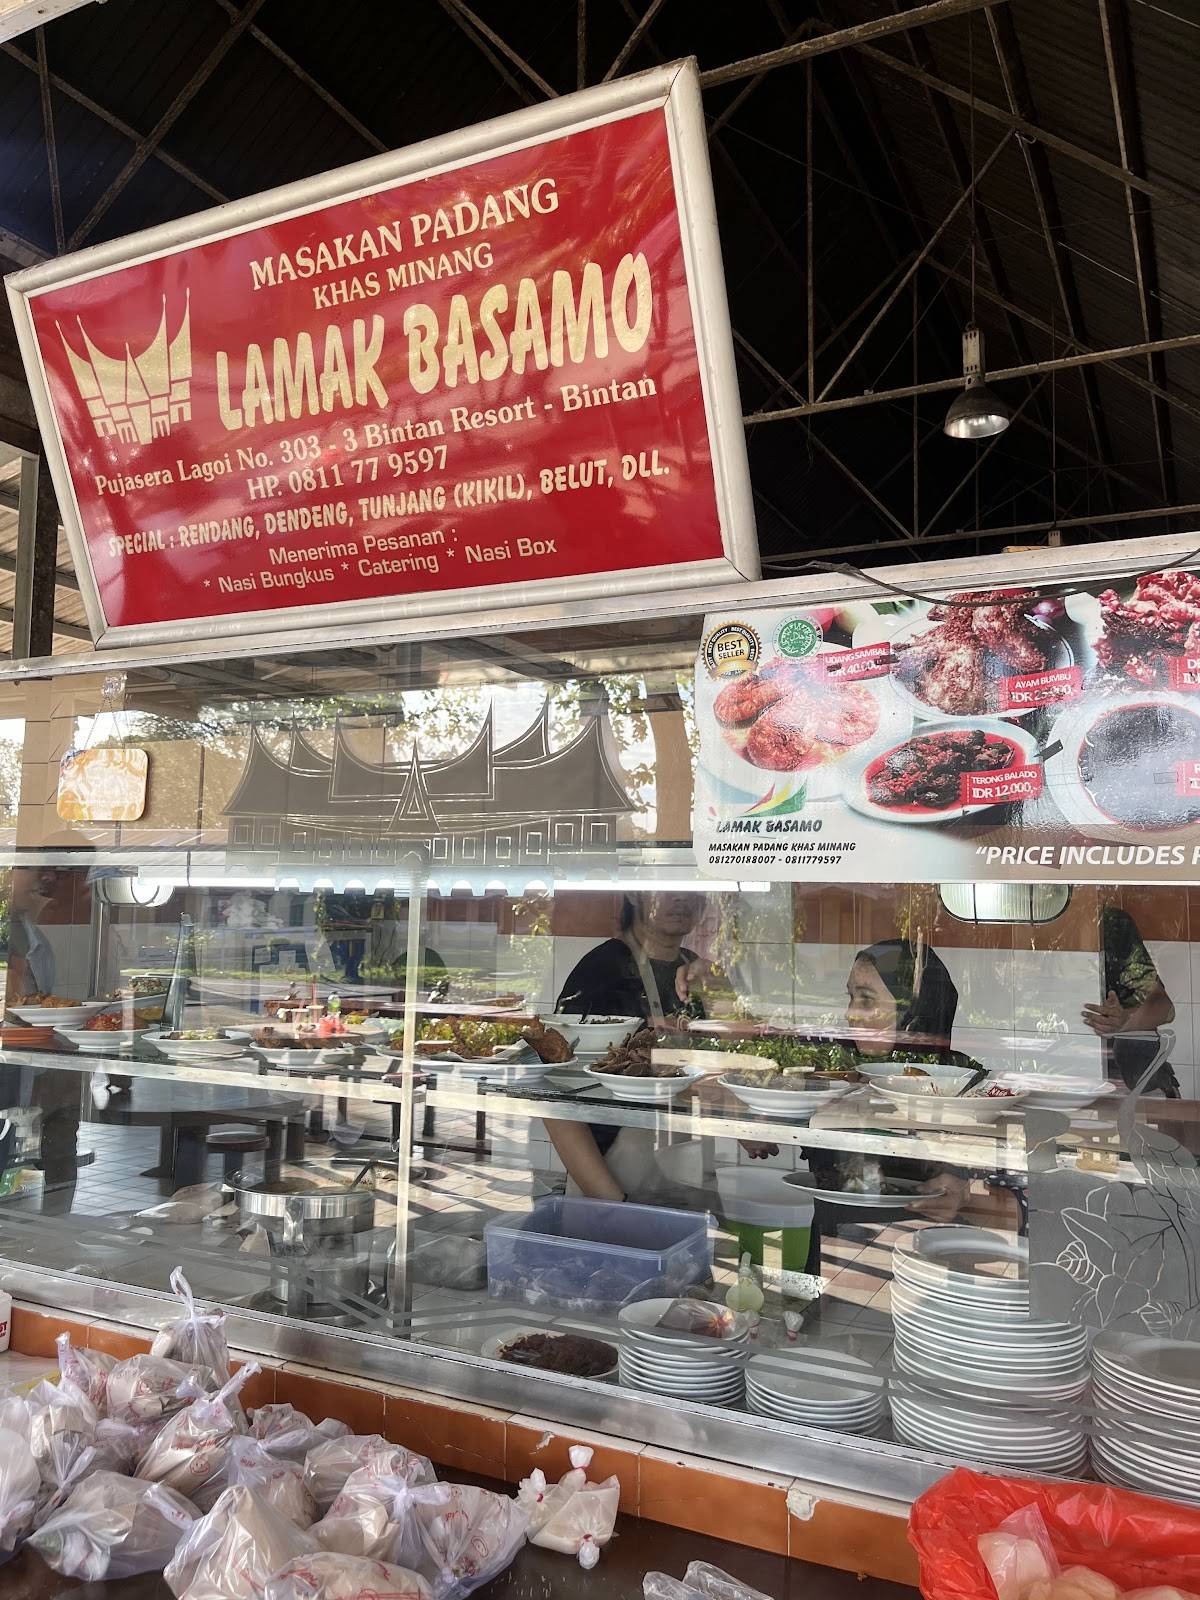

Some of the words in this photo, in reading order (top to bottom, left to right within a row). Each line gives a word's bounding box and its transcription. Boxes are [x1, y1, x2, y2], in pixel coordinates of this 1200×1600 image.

[250, 221, 402, 290] MASAKAN
[411, 178, 559, 247] PADANG
[313, 272, 381, 309] KHAS
[386, 243, 494, 291] MINANG
[216, 314, 389, 430] LAMAK
[403, 252, 653, 394] BASAMO
[95, 469, 174, 497] Pujasera
[177, 453, 232, 483] Lagoi
[236, 448, 273, 471] No.
[279, 435, 322, 464] 303
[344, 428, 358, 452] 3
[364, 416, 445, 449] Bintan
[450, 396, 537, 433] Resort
[560, 377, 657, 412] Bintan
[248, 475, 282, 500] HP.
[288, 465, 344, 494] 0811
[351, 457, 378, 484] 77
[388, 445, 448, 477] 9597
[108, 530, 166, 557] SPECIAL
[178, 516, 260, 548] RENDANG,
[264, 502, 354, 535] DENDENG,
[358, 486, 446, 521] TUNJANG
[453, 473, 533, 509] (KIKIL),
[539, 459, 614, 494] BELUT,
[621, 449, 670, 481] DLL.
[268, 541, 358, 565] Menerima
[363, 530, 445, 554] Pesanan
[218, 573, 256, 593] Nasi
[262, 566, 334, 589] Bungkus
[358, 554, 439, 577] Catering
[464, 540, 512, 564] Nasi
[517, 537, 557, 557] Box
[717, 639, 743, 652] BEST
[718, 649, 745, 659] SELLER
[825, 654, 855, 664] UDANG
[855, 648, 888, 660] SAMBAL
[1015, 679, 1039, 688] AYAM
[1040, 673, 1071, 685] BUMBU
[1011, 691, 1033, 703] IDR
[971, 775, 1004, 784] TERONG
[1004, 771, 1037, 780] BALADO
[972, 787, 993, 798] IDR
[716, 820, 762, 833] LAMAK
[765, 820, 823, 833] BASAMO
[708, 843, 750, 851] MASAKAN
[752, 843, 789, 851] PADANG
[791, 842, 815, 851] KHAS
[817, 842, 856, 851] MINANG
[708, 855, 775, 864] 081270188007
[785, 855, 842, 864] 0811779597
[1059, 845, 1185, 865] INCLUDES
